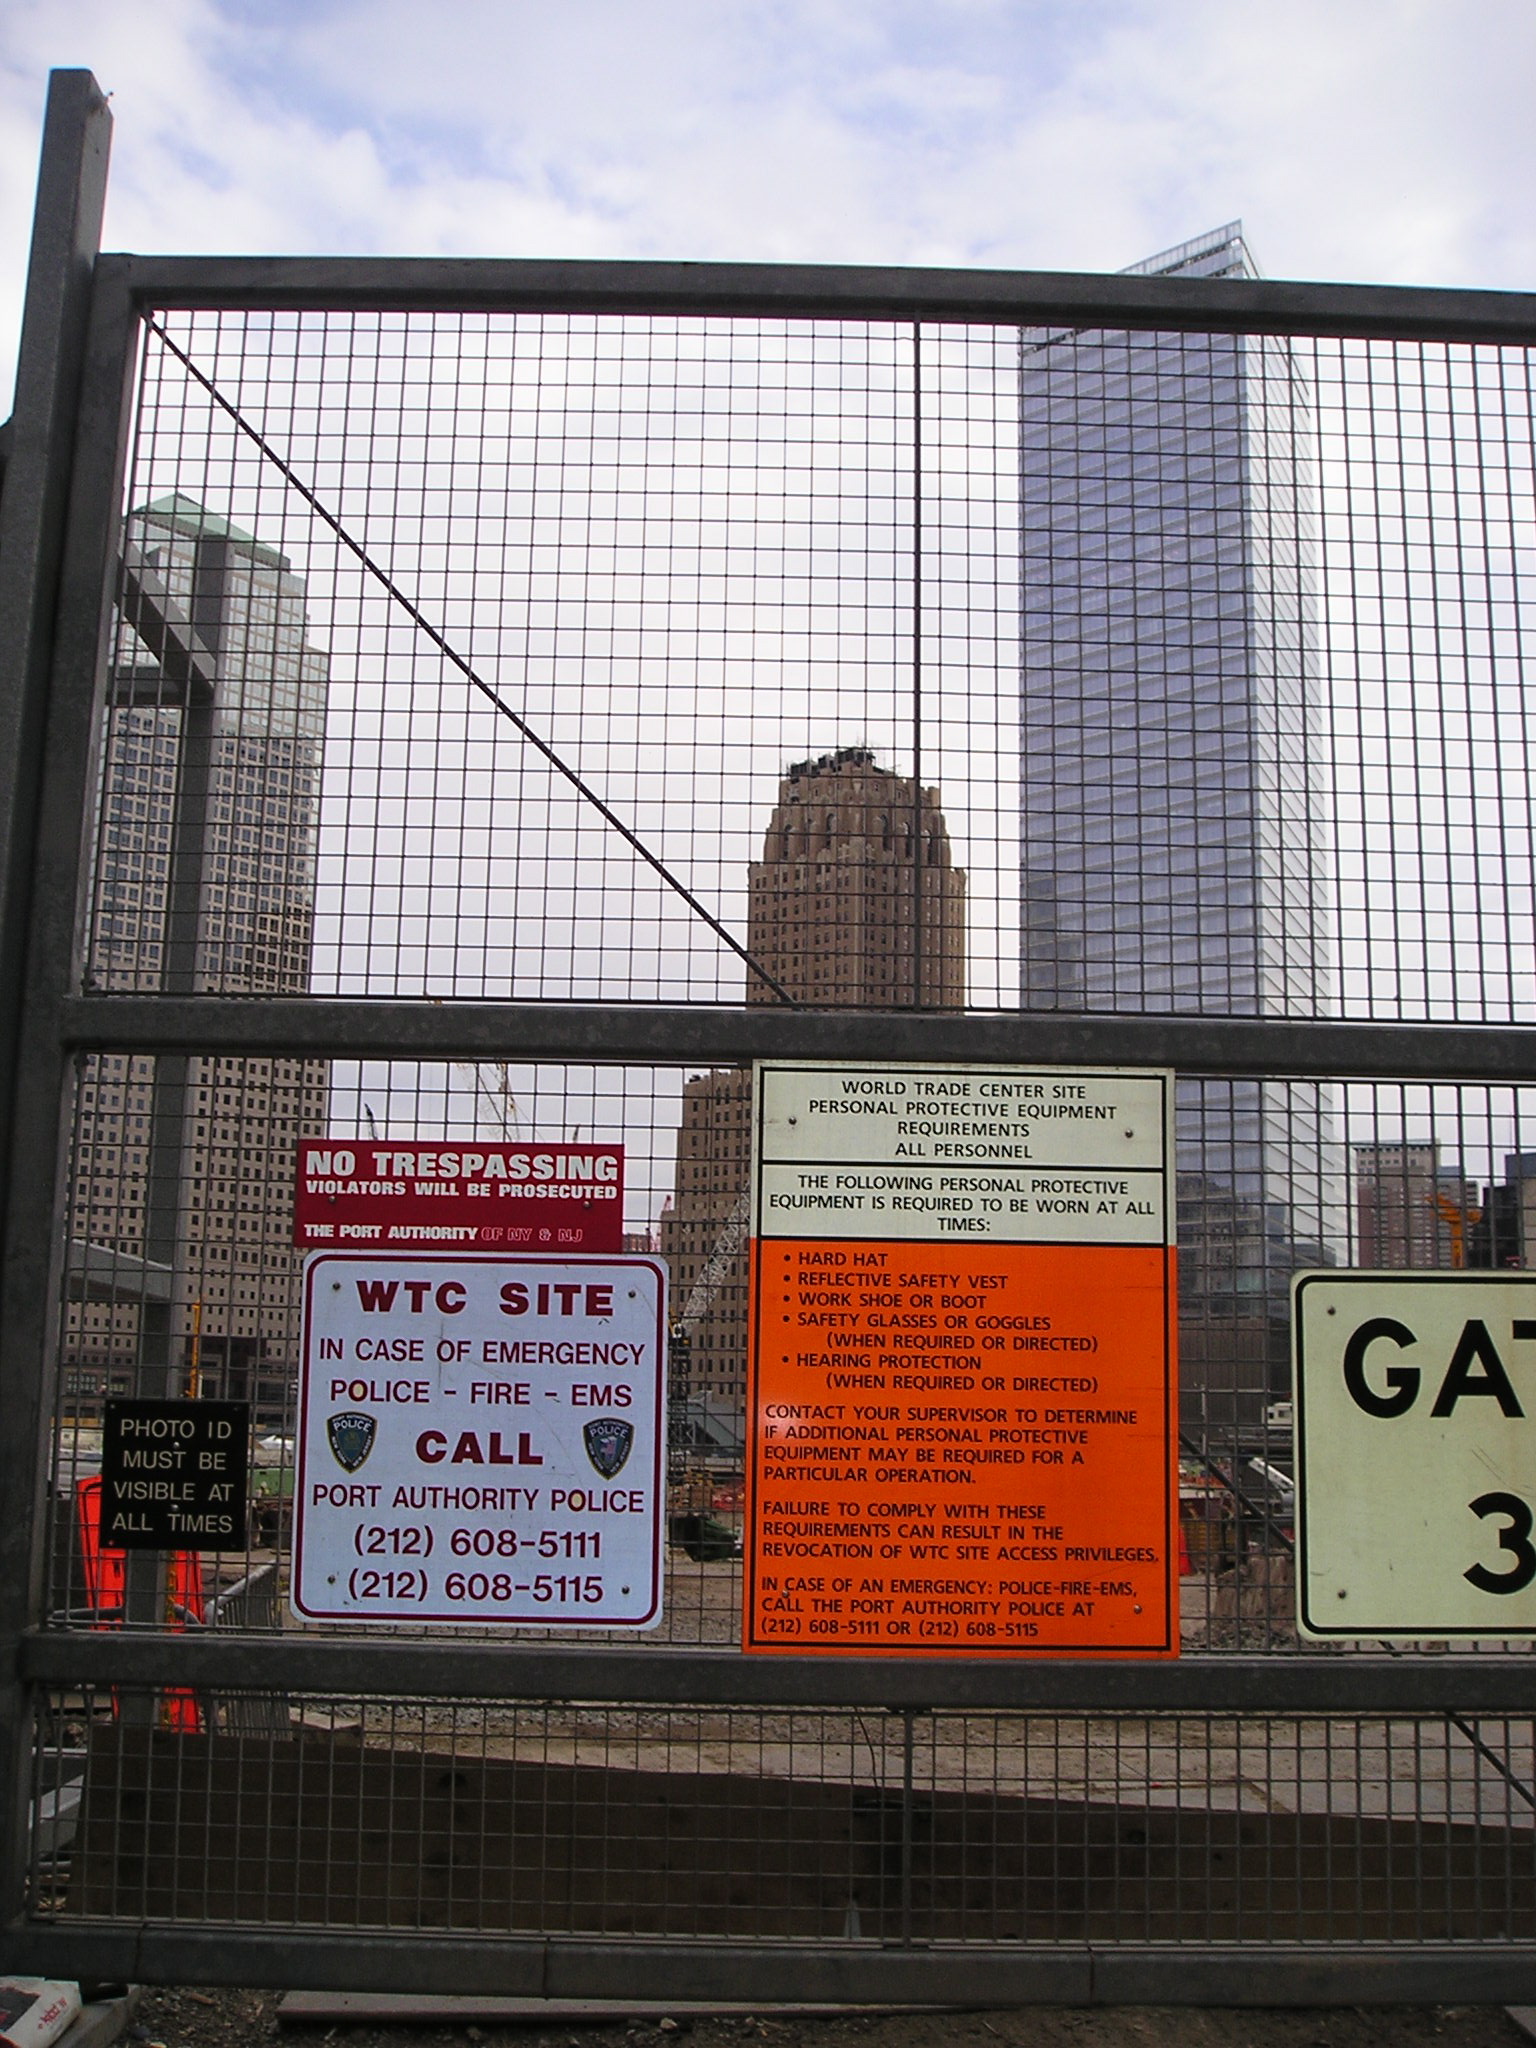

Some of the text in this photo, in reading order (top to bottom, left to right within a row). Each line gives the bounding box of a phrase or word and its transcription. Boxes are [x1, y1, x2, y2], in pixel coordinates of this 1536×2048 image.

[842, 1081, 1085, 1098] WORLD TRADE CENTER SITE
[810, 1100, 1116, 1119] PERSONAL PROTECTIVE EQUIPMENT
[898, 1122, 1029, 1137] REQUIREMENTS
[896, 1143, 1032, 1158] ALL PERSONNEL
[306, 1151, 617, 1181] NO TRESPASSING
[306, 1180, 617, 1198] VIOLATORS WILL BE PROSECUTED
[798, 1175, 1128, 1194] THE FOLLOWING PERSONAL PROTECTIVE
[770, 1195, 1154, 1214] EQUIPMENT IS REQUIRED TO BE WORN AT ALL
[304, 1224, 582, 1242] THE PORT AUTHORITY OF NY & NJ
[937, 1218, 990, 1231] TIMES:
[799, 1252, 888, 1266] HARD HAT
[799, 1272, 1008, 1288] REFLECTIVE SAFETY VEST
[356, 1281, 613, 1316] WTC SITE
[799, 1292, 987, 1308] WORK SHOE OR BOOT
[798, 1312, 1050, 1330] SAFETY GLASSES OR GOGGLES
[320, 1338, 645, 1365] IN CASE OF EMERGENCY
[827, 1332, 1098, 1352] (WHEN REQUIRED OR DIRECTED)
[797, 1353, 981, 1370] HEARING PROTECTION
[827, 1372, 1098, 1393] (WHEN REQUIRED OR DIRECTED)
[331, 1380, 429, 1403] POLICE
[471, 1383, 530, 1404] FIRE
[572, 1385, 631, 1407] EMS
[766, 1404, 1137, 1424] CONTACT YOUR SUPERVISOR TO DETERMINE
[121, 1419, 231, 1438] PHOTO ID
[333, 1419, 372, 1432] POLICE
[590, 1426, 628, 1438] POLICE
[765, 1426, 1088, 1444] IF ADDITIONAL PERSONAL PROTECTIVE
[416, 1431, 543, 1465] CALL
[764, 1446, 1084, 1465] EQUIPMENT MAY BE REQUIRED FOR A
[124, 1451, 226, 1470] MUST BE
[764, 1466, 976, 1483] PARTICULAR OPERATION.
[114, 1482, 234, 1501] VISIBLE AT
[313, 1484, 644, 1512] PORT AUTHORITY POLICE
[764, 1501, 1045, 1519] FAILURE TO COMPLY WITH THESE
[113, 1513, 232, 1533] ALL TIMES
[763, 1522, 1063, 1540] REQUIREMENTS CAN RESULT IN THE
[355, 1524, 600, 1558] (212) 608-5111
[1463, 1492, 1536, 1595] 3
[763, 1542, 872, 1558] REVOCATION
[880, 1544, 902, 1558] OF
[910, 1545, 948, 1559] WTC
[957, 1546, 989, 1560] SITE
[997, 1547, 1057, 1560] ACCESS
[349, 1568, 603, 1602] (212) 608-5115
[762, 1577, 777, 1590] IN
[785, 1578, 824, 1591] CASE
[832, 1578, 852, 1592] OF
[860, 1579, 883, 1592] AN
[891, 1580, 992, 1594] EMERGENCY:
[762, 1596, 1094, 1616] CALL THE PORT AUTHORITY POLICE AT
[762, 1617, 1038, 1638] (212) 608-5111 OR (212) 608-5115
